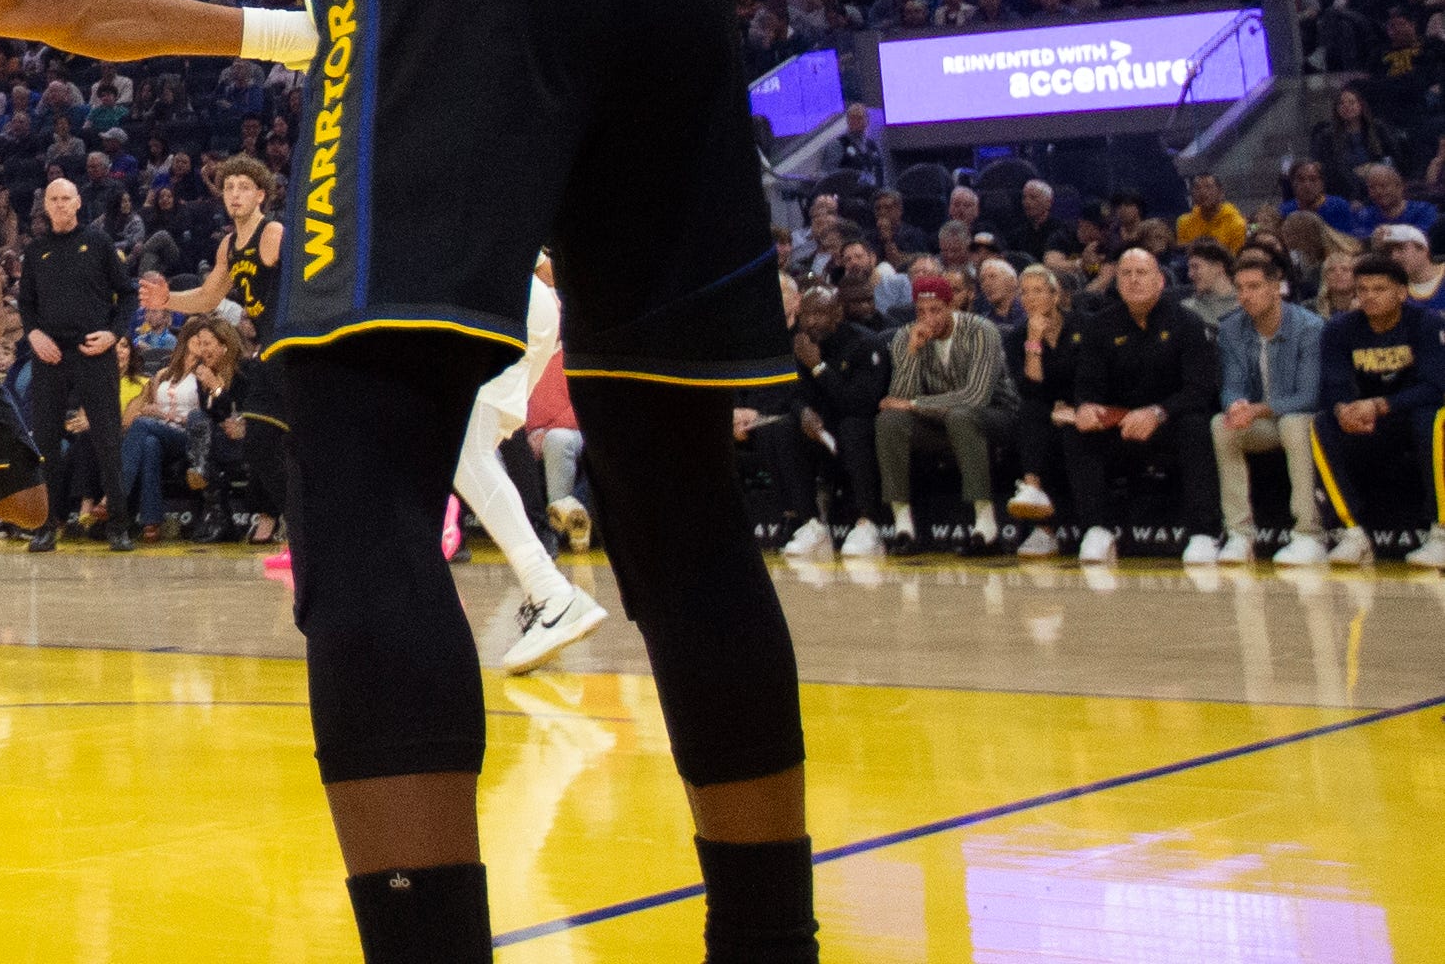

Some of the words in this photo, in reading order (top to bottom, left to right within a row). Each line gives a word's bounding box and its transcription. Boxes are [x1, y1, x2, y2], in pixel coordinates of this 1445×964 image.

[942, 48, 1054, 75] REINVENTED
[1056, 43, 1107, 65] WITH
[1009, 58, 1194, 98] accenture
